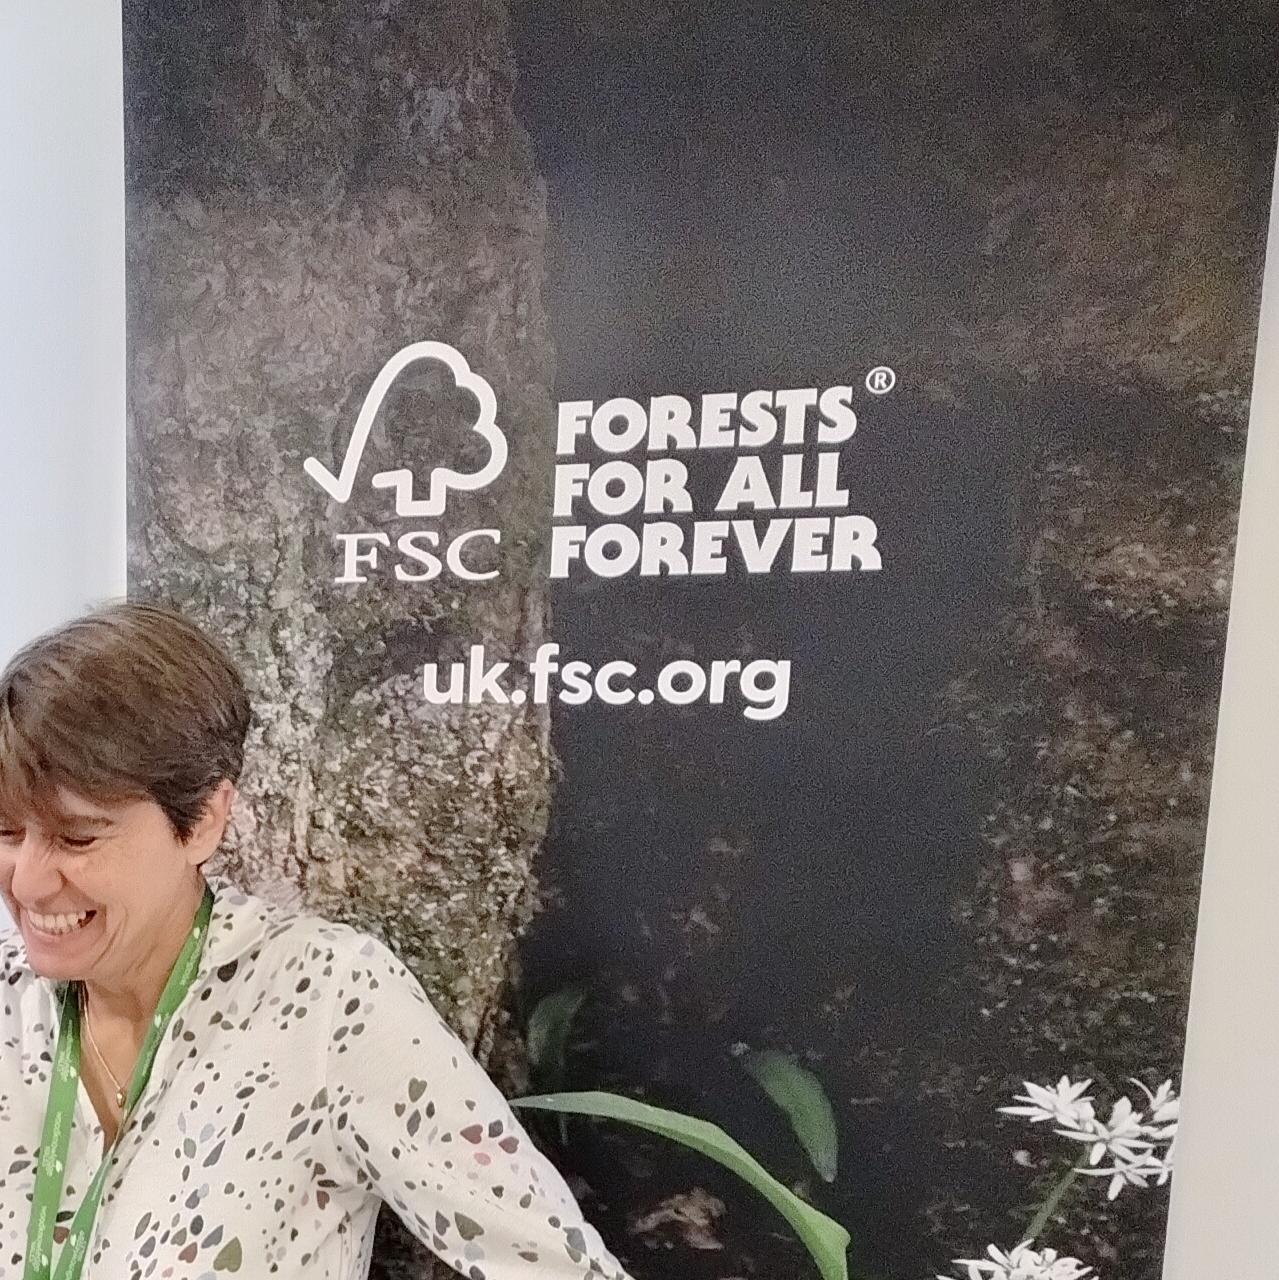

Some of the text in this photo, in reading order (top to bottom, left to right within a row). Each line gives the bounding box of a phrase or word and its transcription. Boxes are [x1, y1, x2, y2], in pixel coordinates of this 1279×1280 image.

[553, 452, 849, 516] FOR ALL
[333, 529, 501, 584] FSC
[550, 515, 882, 579] FOREVER
[423, 643, 791, 721] uk.fsc.org
